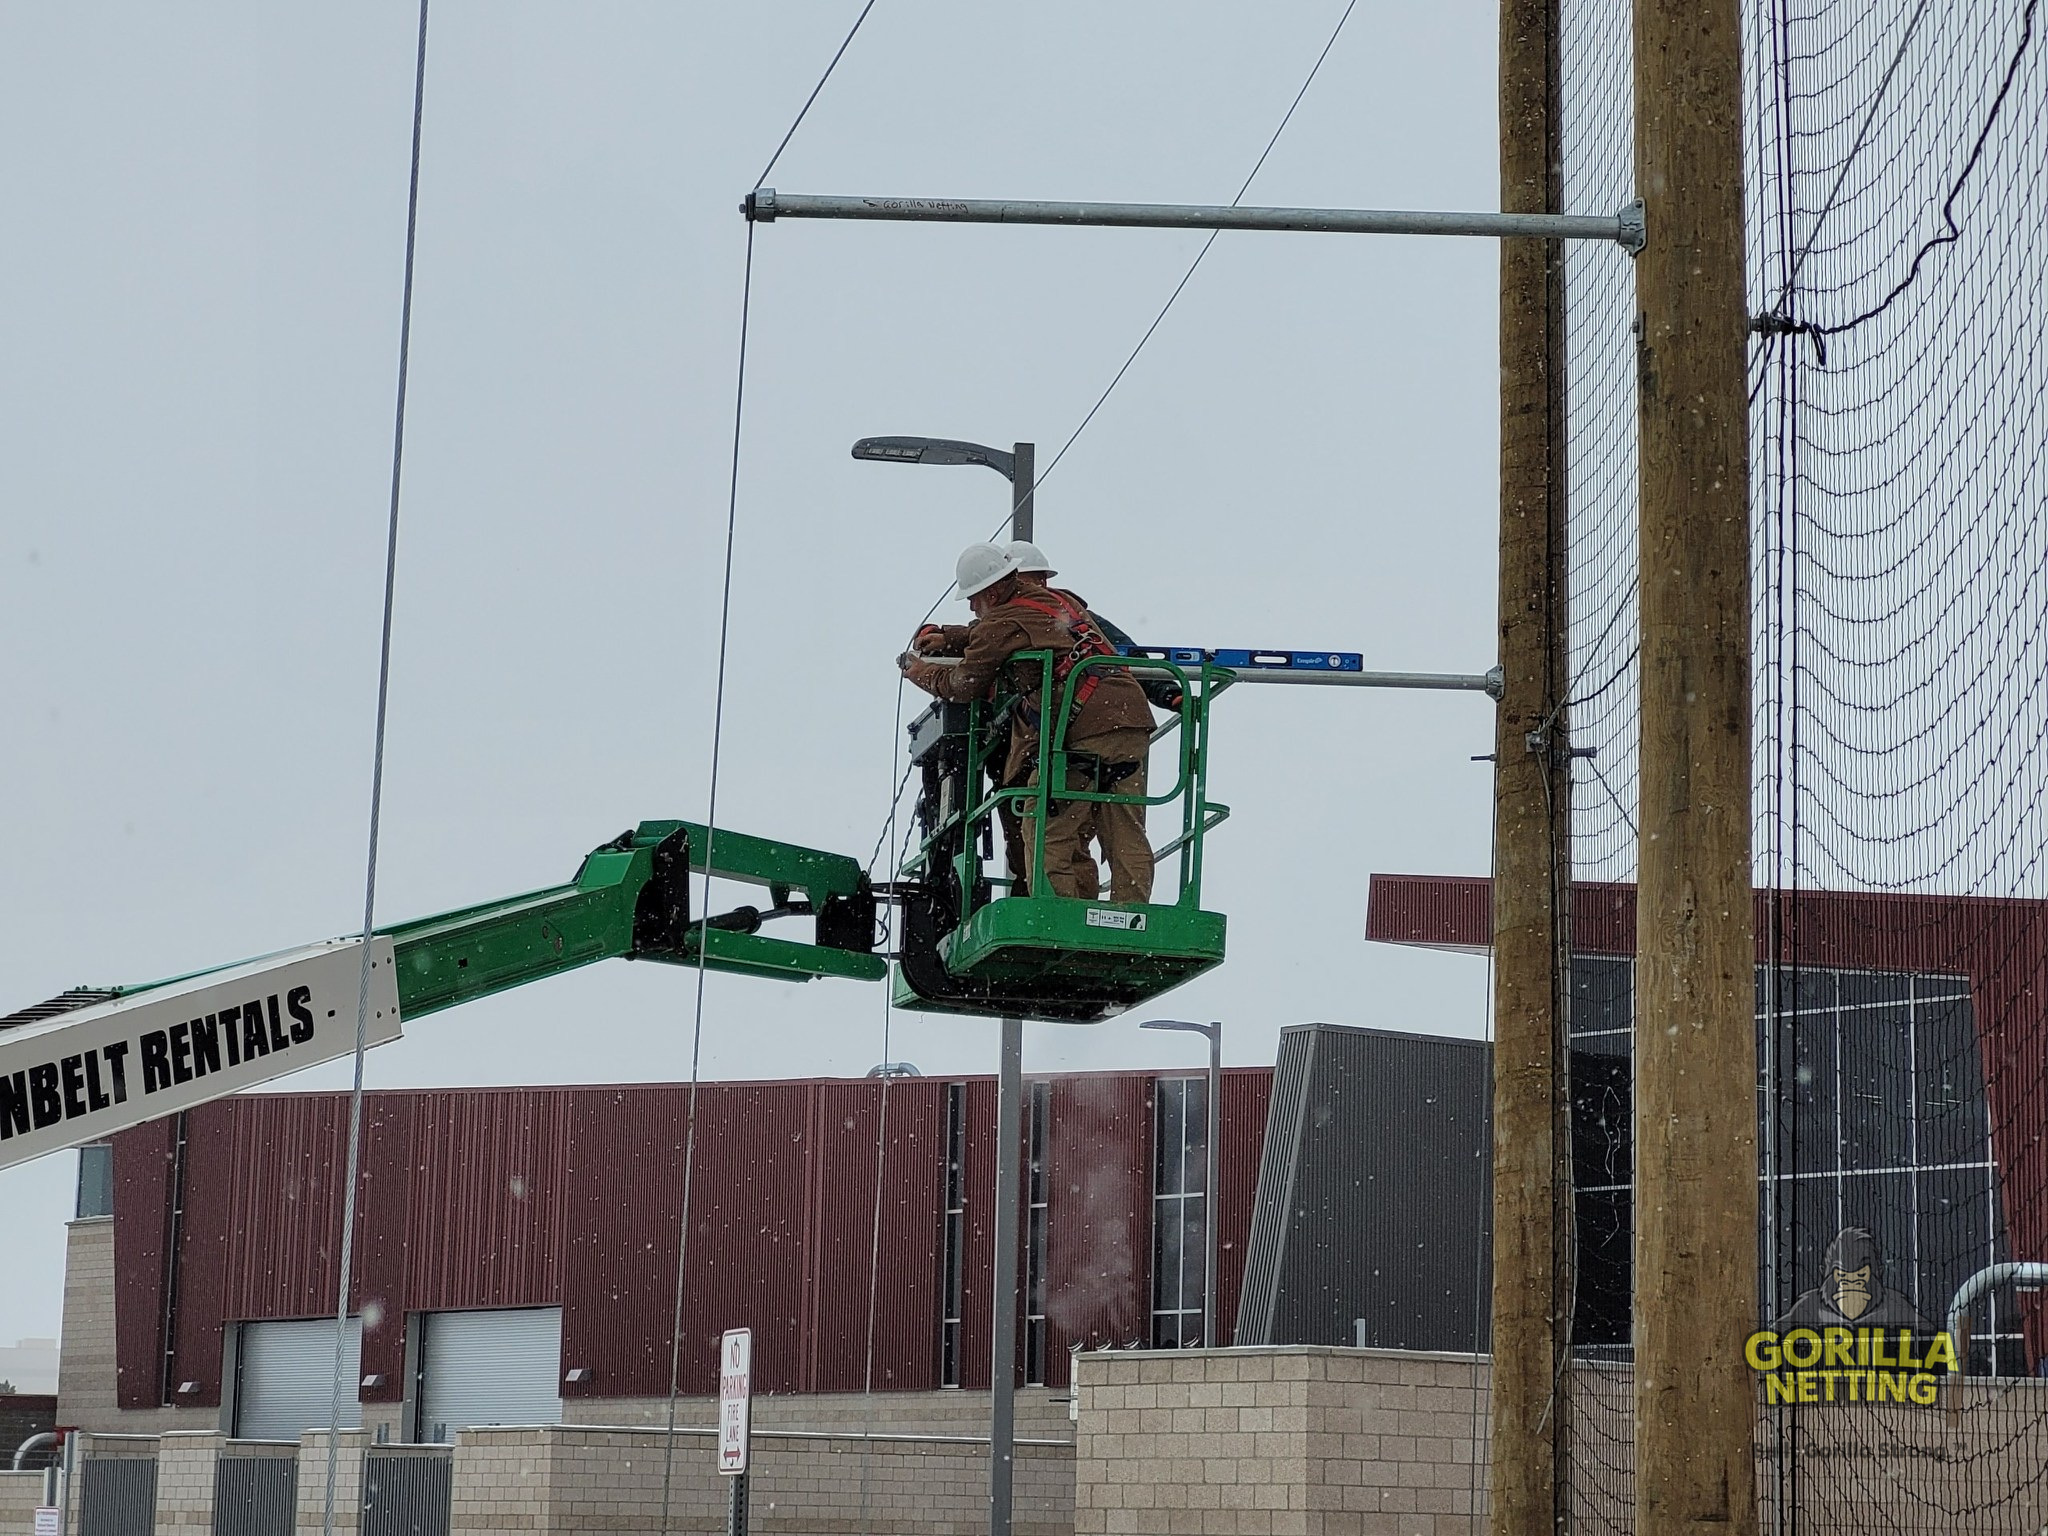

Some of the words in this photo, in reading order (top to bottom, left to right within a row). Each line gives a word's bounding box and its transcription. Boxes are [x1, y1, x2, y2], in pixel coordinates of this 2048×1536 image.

[928, 201, 969, 214] Netting
[139, 985, 315, 1095] RENTALS
[729, 1343, 741, 1370] NO
[722, 1373, 747, 1400] PARKING
[727, 1403, 739, 1422] FIRE
[726, 1424, 739, 1443] LANE
